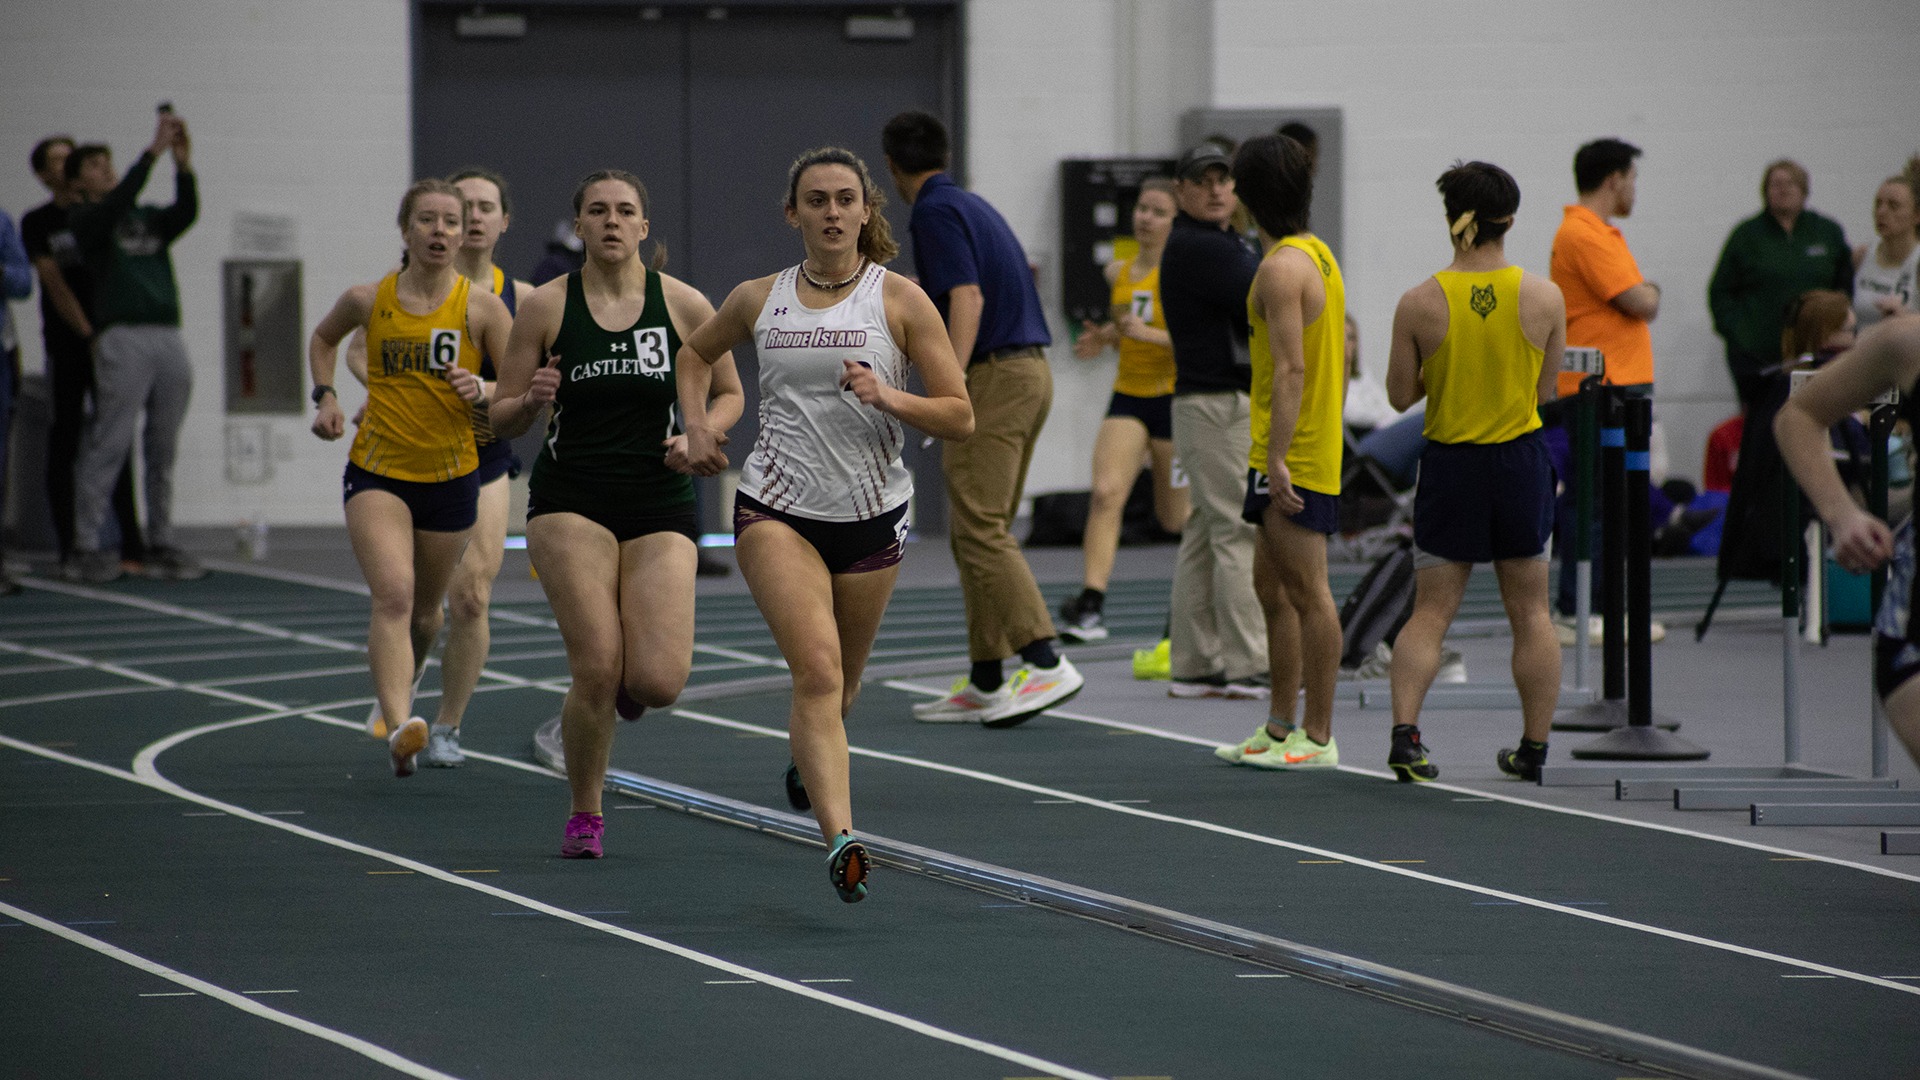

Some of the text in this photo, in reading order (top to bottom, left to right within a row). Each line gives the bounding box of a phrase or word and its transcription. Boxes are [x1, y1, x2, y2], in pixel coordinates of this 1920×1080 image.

[1135, 296, 1149, 318] 7
[434, 331, 456, 367] 6
[640, 331, 665, 369] 3
[765, 327, 867, 349] RHODE ISLAND
